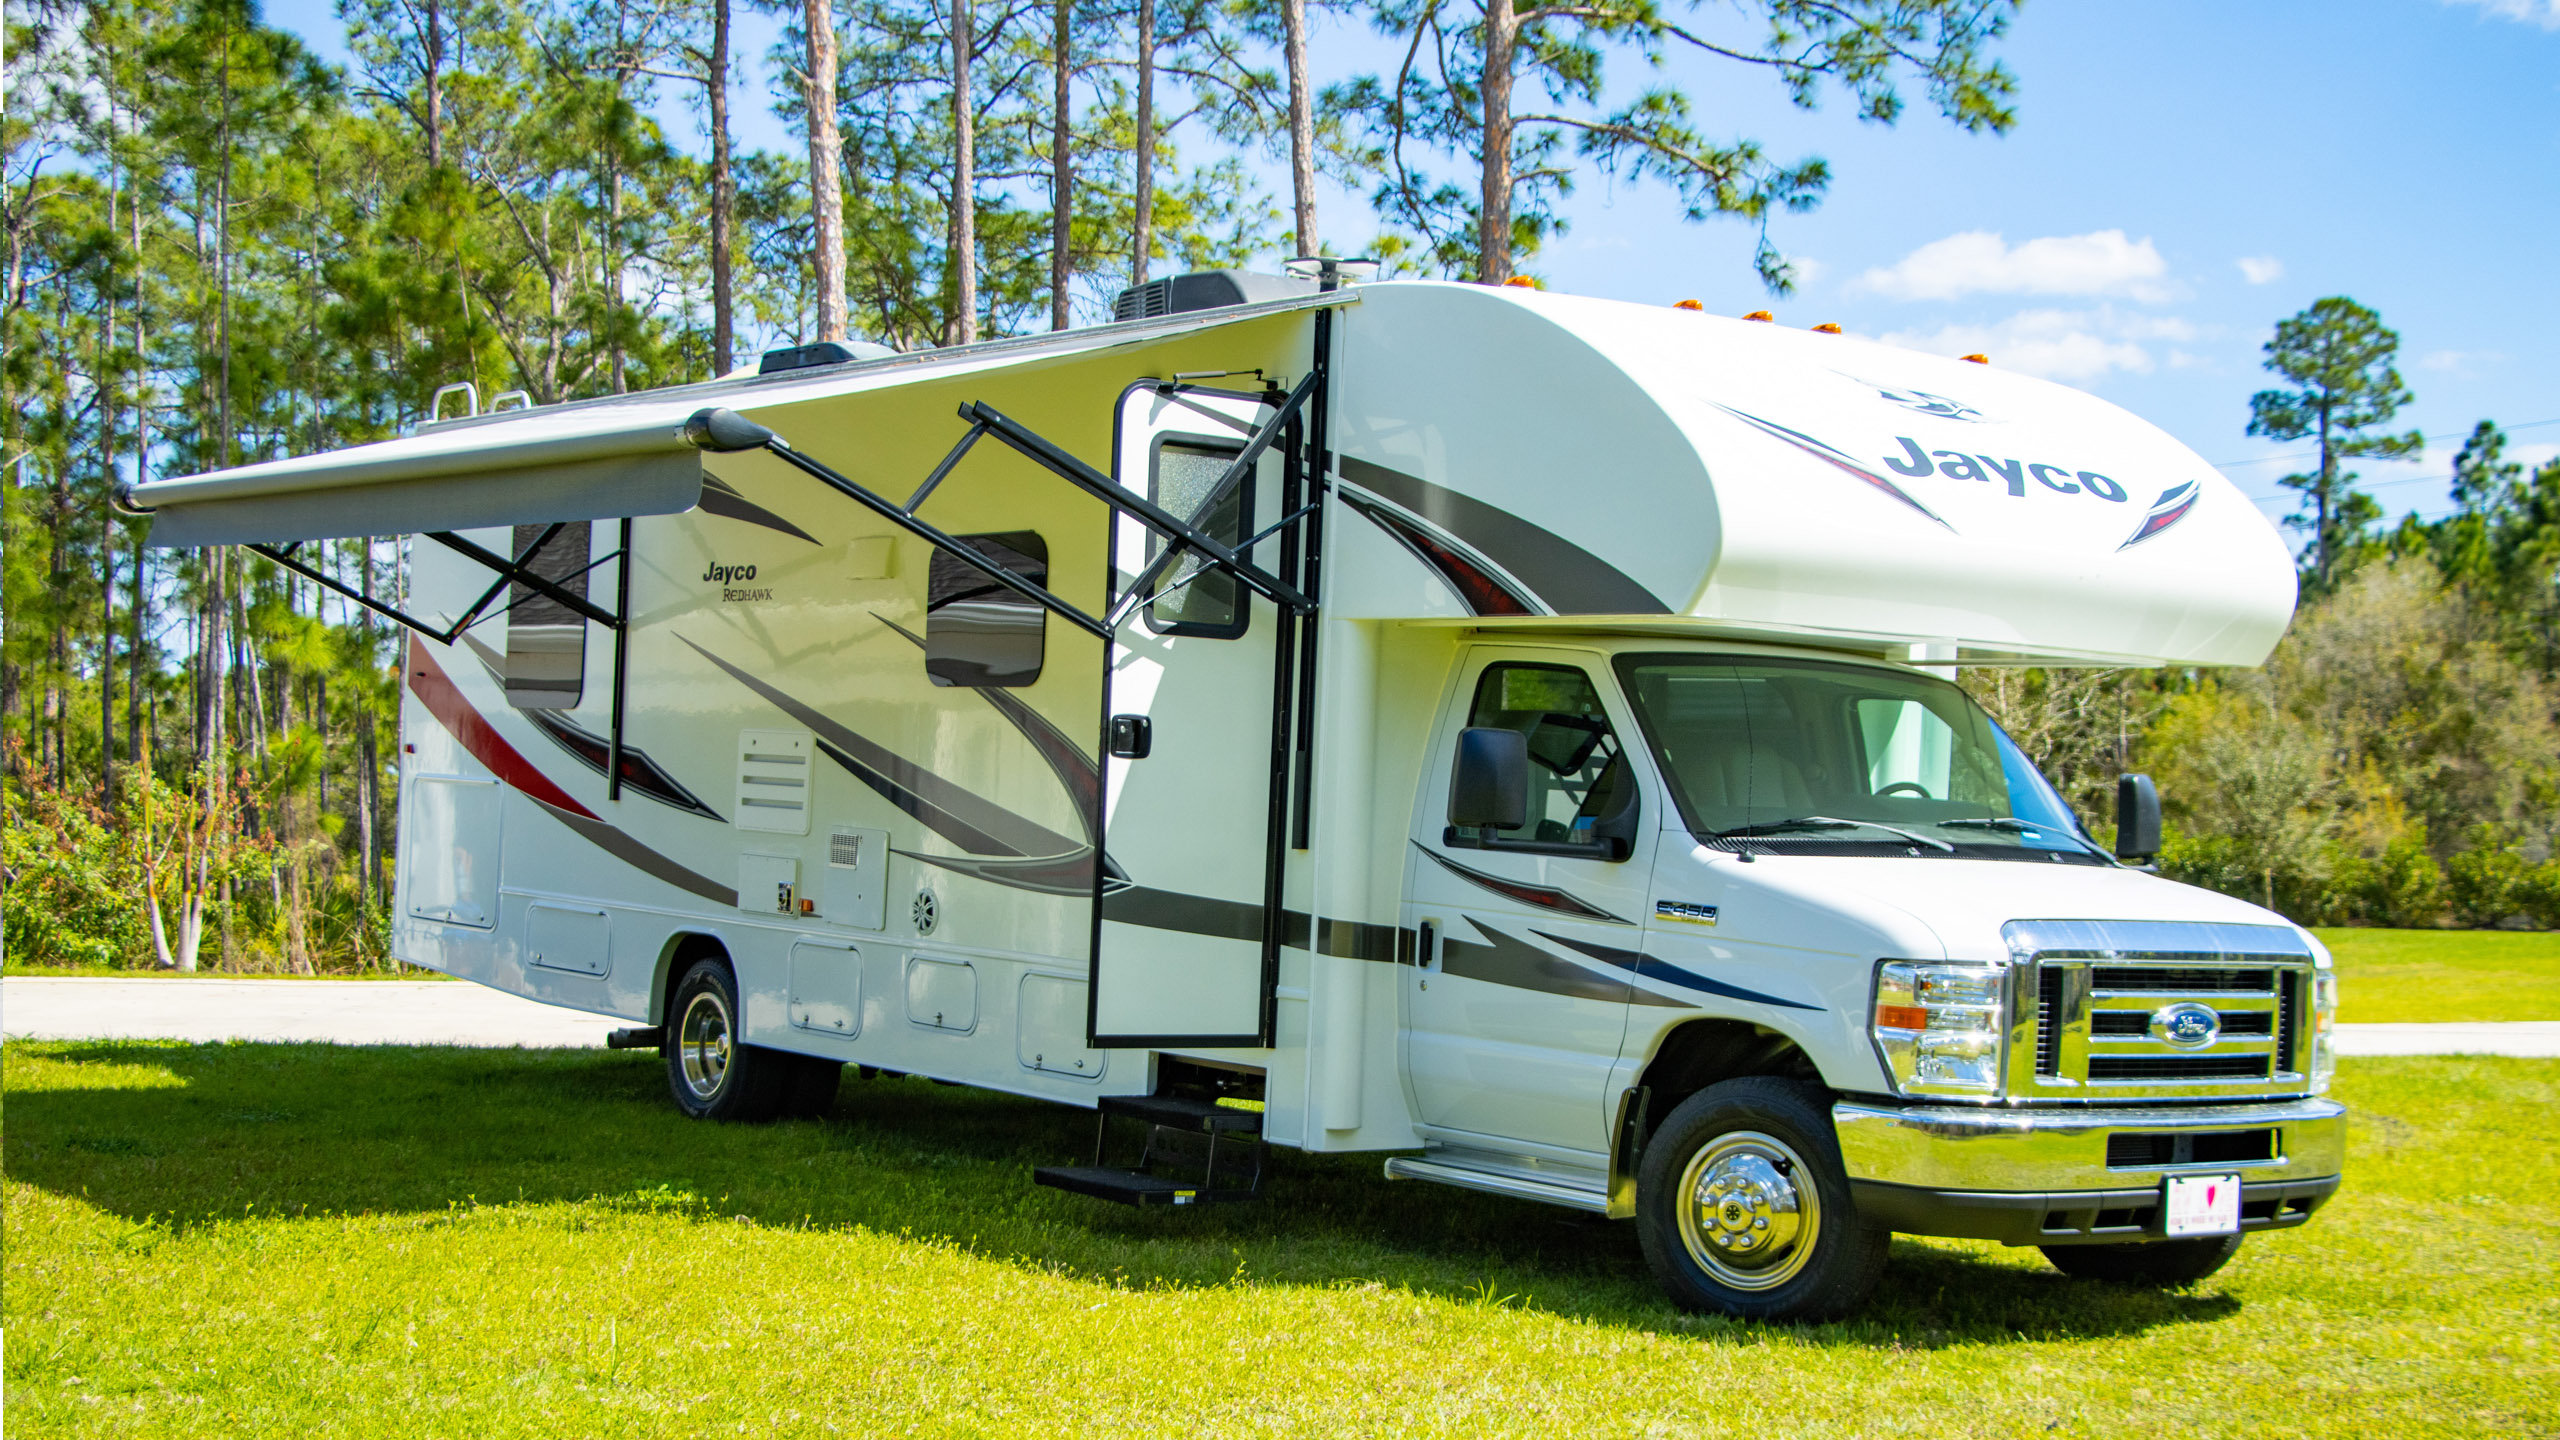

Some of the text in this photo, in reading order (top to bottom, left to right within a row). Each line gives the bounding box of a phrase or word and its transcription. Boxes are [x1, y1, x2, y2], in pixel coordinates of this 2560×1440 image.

[1882, 436, 2128, 503] Jayco
[703, 561, 757, 585] Jayco
[722, 588, 773, 602] REDHAWK
